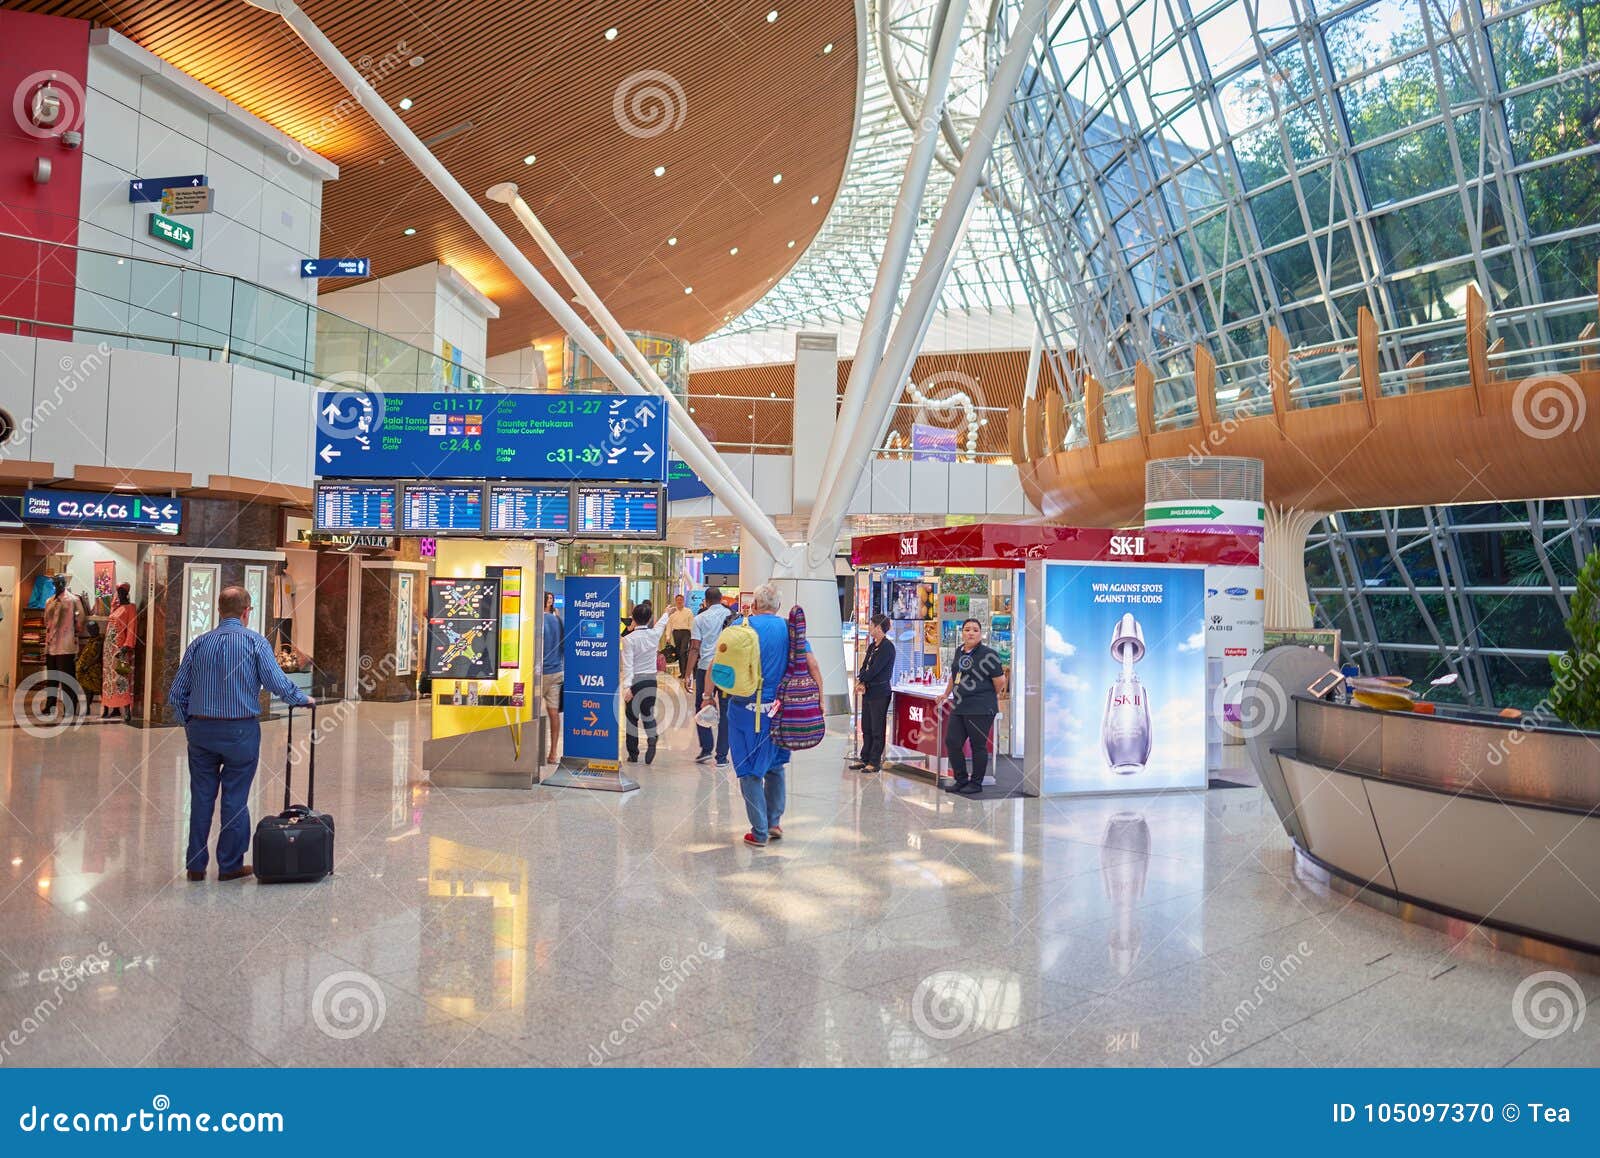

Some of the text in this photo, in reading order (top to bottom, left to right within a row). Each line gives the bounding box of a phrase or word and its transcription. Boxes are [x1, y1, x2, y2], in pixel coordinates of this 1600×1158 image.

[383, 398, 404, 406] Pintu
[497, 399, 517, 407] Pintu
[405, 417, 428, 425] Tamu
[497, 420, 574, 428] Kaunter Pertukaran
[382, 437, 402, 445] Pintu
[496, 447, 516, 456] Pintu
[28, 497, 128, 519] Pintu C2,C4,C6
[28, 506, 51, 515] Gates
[901, 537, 918, 555] SK-II
[1109, 535, 1145, 556] SK-II
[1092, 583, 1163, 592] WIN AGAINST SPOTS
[585, 591, 598, 600] get
[1094, 594, 1162, 603] AGAINST THE ODDS
[574, 600, 610, 609] Malaysian
[579, 609, 605, 618] Ringgit
[575, 640, 608, 649] with your
[575, 648, 608, 657] Visa card
[578, 674, 605, 687] VISA
[582, 700, 600, 709] 50m
[581, 728, 593, 736] the
[593, 729, 609, 737] ATM
